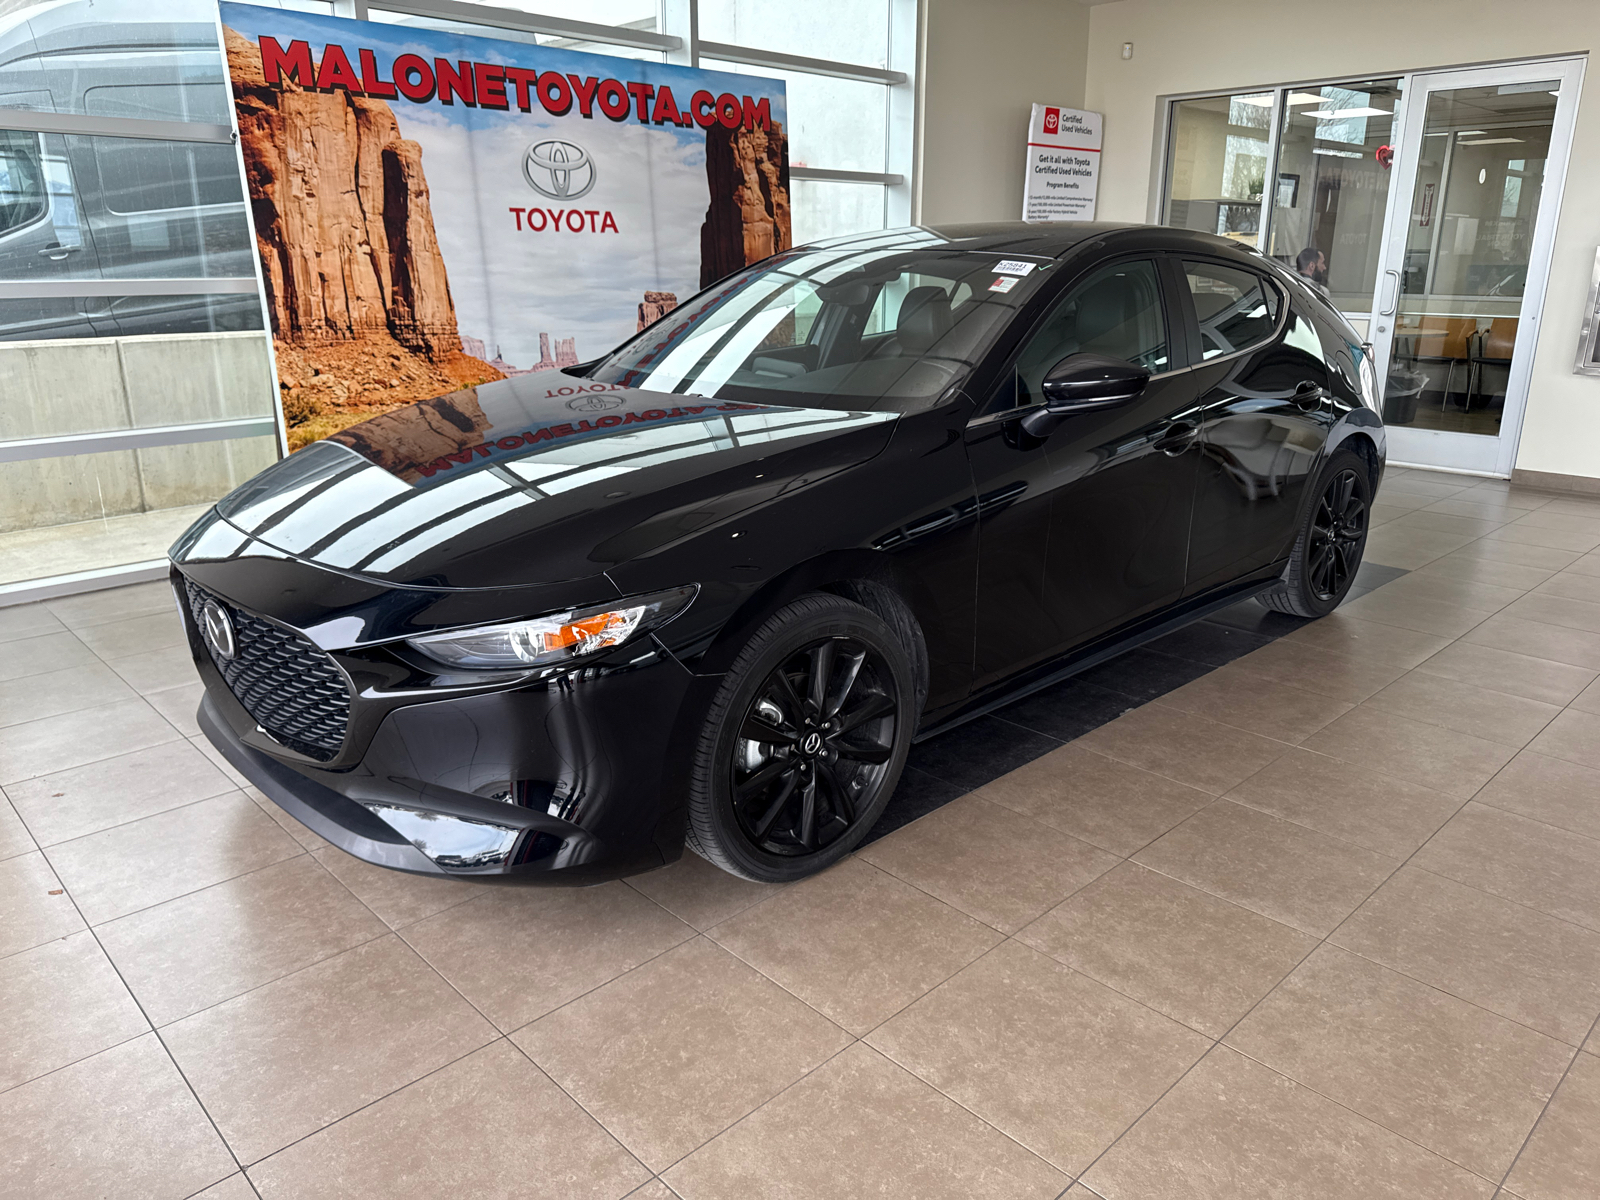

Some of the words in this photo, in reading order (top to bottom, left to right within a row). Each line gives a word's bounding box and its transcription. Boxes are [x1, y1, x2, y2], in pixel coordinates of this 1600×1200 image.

[258, 35, 773, 133] MALONETOYOTA.COM
[1062, 114, 1083, 124] Certified
[1061, 124, 1074, 133] Used
[1074, 125, 1093, 135] Vehicles
[1039, 154, 1050, 163] Get
[1049, 155, 1054, 164] it
[1061, 156, 1073, 165] with
[1074, 157, 1091, 167] Toyota
[1035, 165, 1058, 175] Certified
[1059, 166, 1072, 176] Used
[1072, 167, 1092, 177] Vehicles
[1046, 181, 1063, 190] Program
[509, 207, 620, 234] TOYOTA
